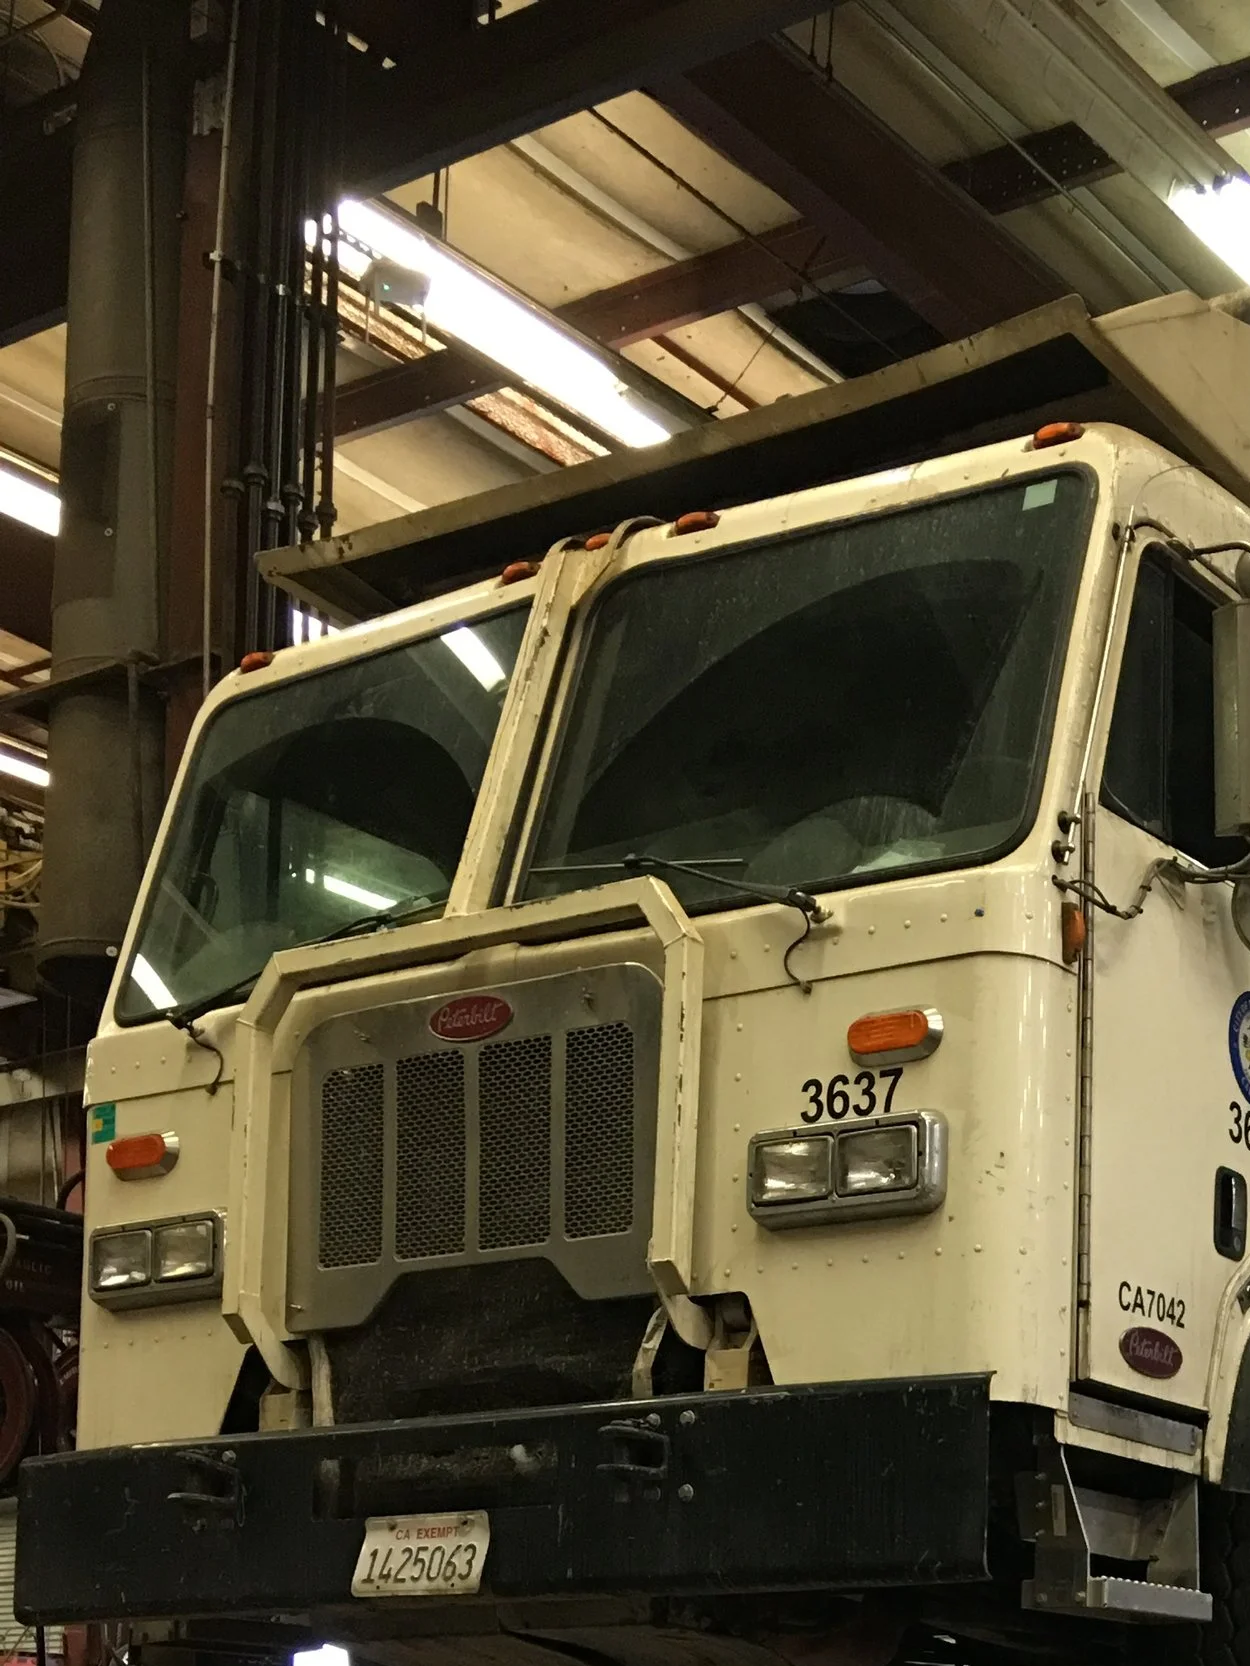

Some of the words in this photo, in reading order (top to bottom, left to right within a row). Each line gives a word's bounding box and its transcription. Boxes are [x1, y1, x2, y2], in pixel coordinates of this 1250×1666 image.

[438, 1002, 503, 1033] Peterbilt
[800, 1067, 904, 1123] 3637
[1118, 1280, 1186, 1329] CA7042
[1128, 1329, 1179, 1367] Peterbilt
[395, 1529, 411, 1541] CA
[416, 1525, 460, 1540] EXEMPT
[360, 1542, 478, 1585] 1425063
